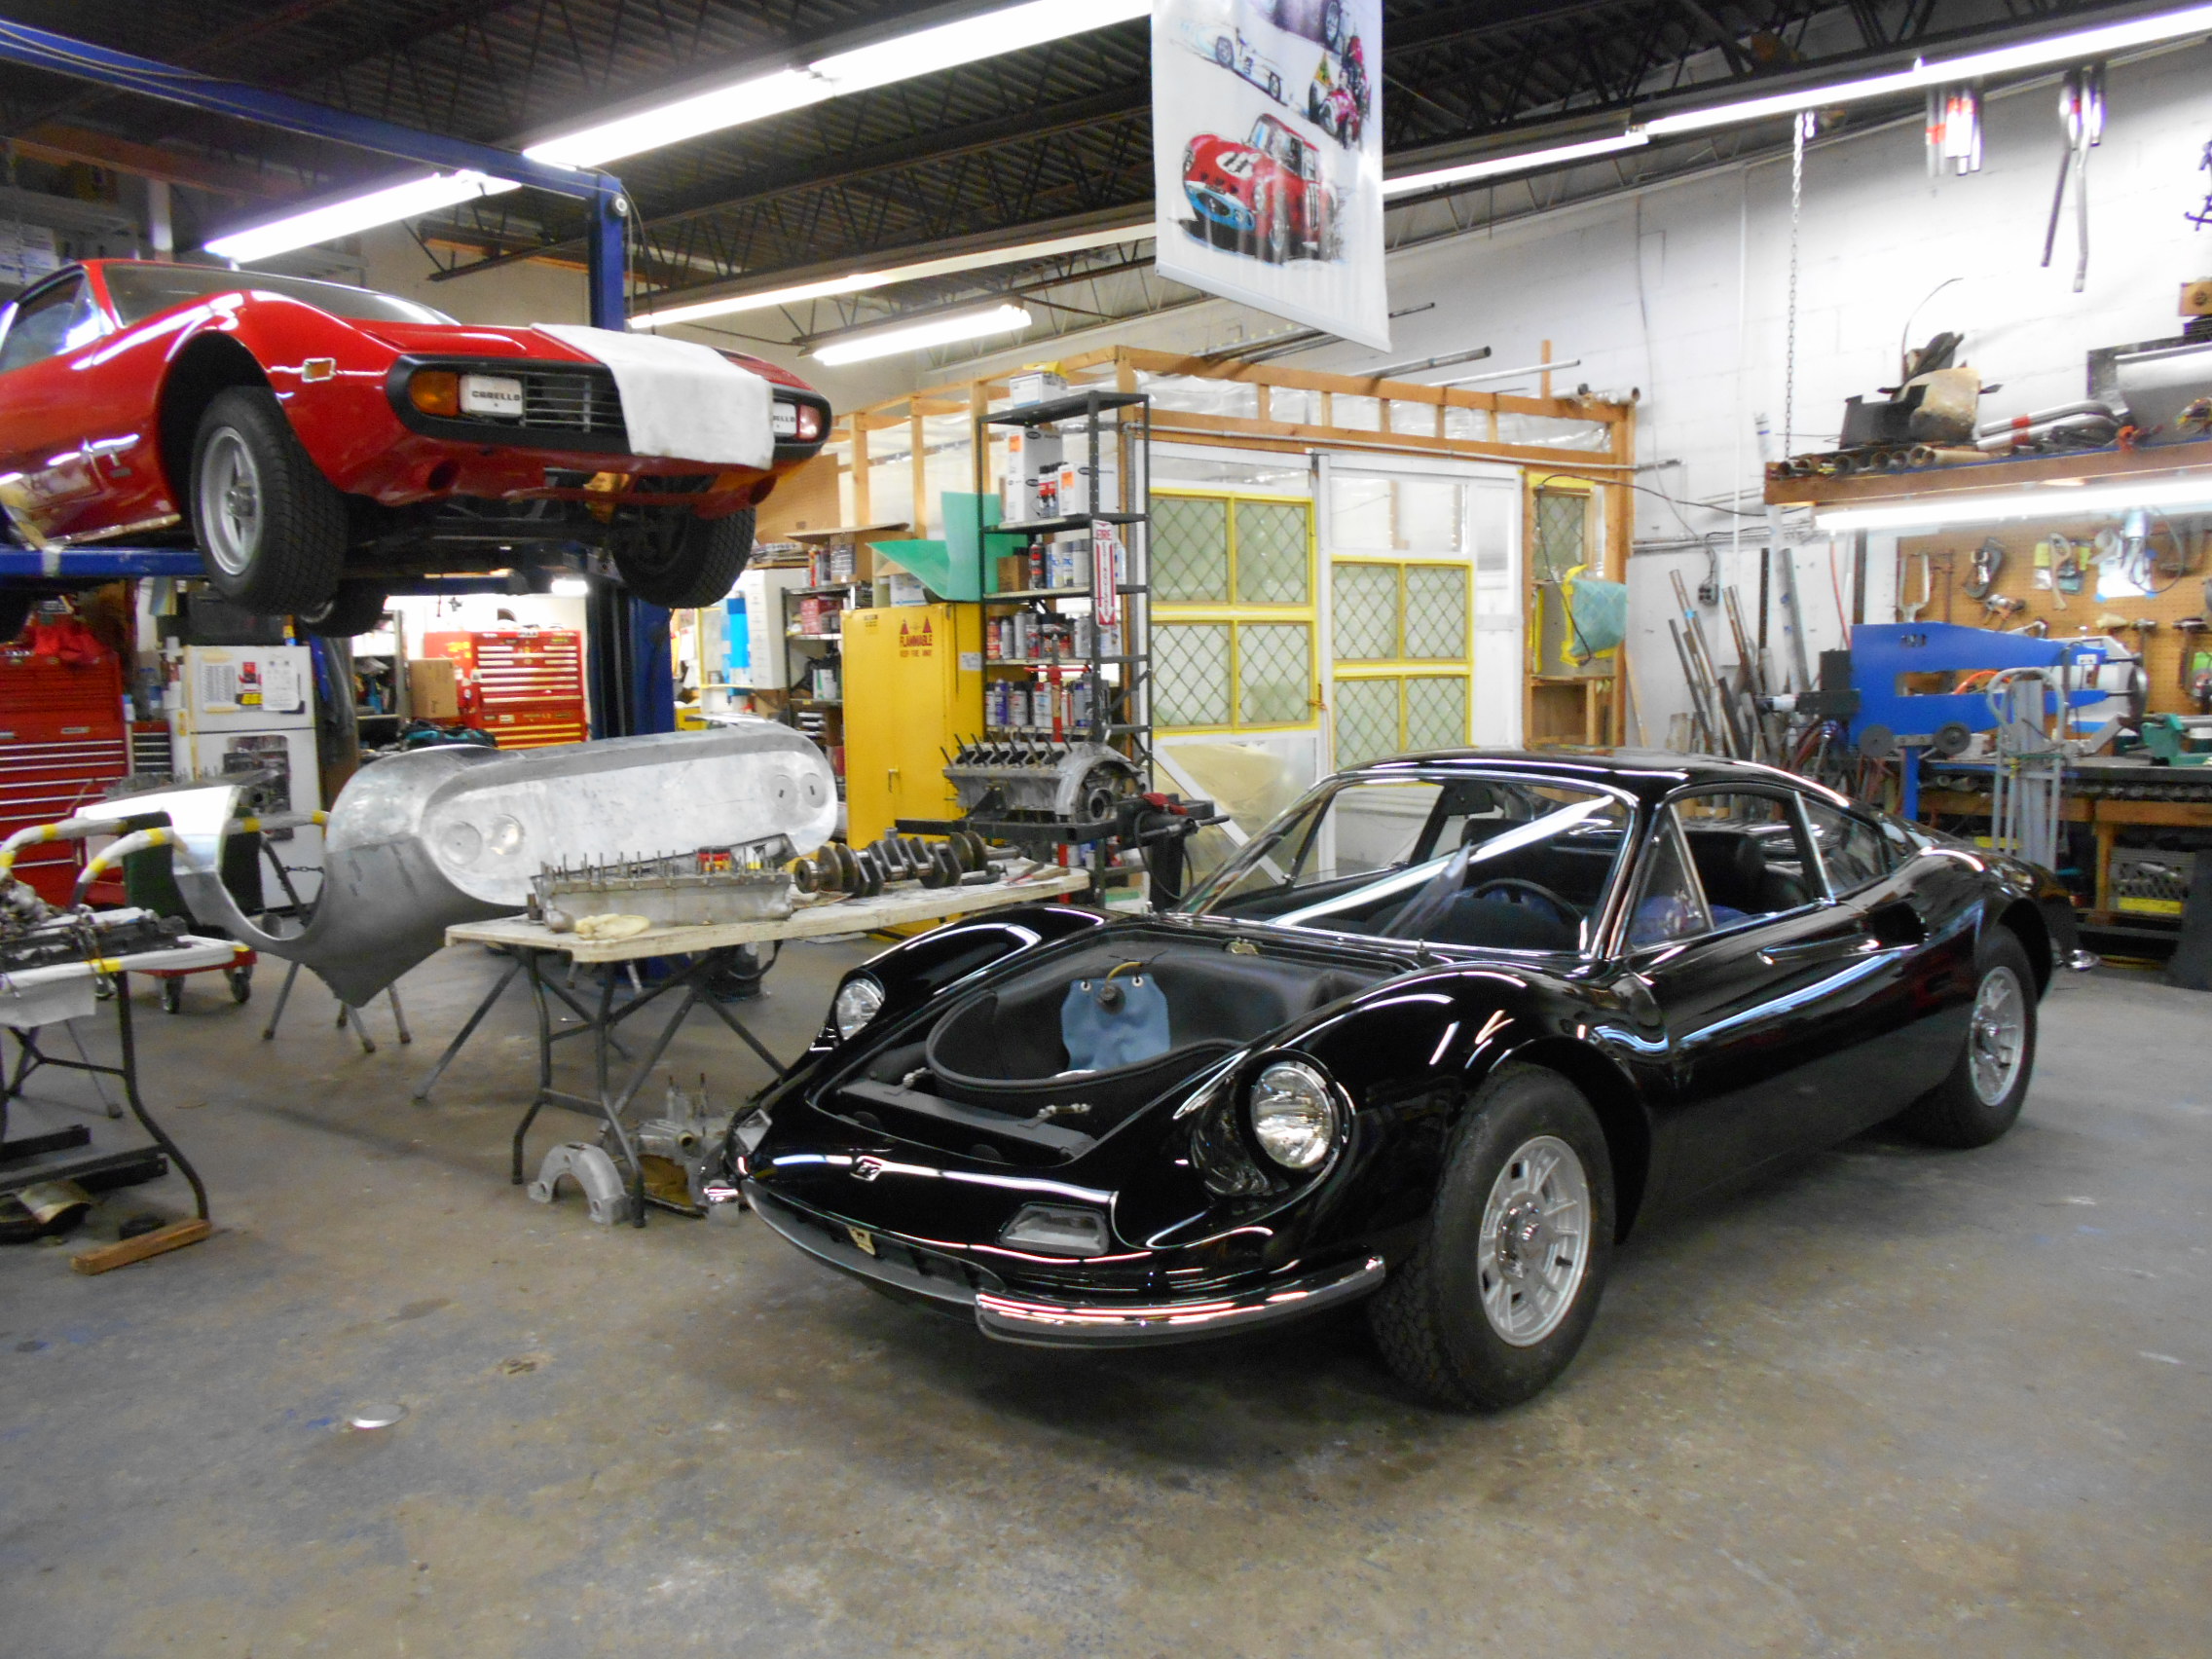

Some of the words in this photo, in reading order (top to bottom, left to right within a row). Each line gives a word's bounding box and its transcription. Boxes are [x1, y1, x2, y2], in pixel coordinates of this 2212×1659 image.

[472, 390, 521, 401] CARELLO
[1096, 529, 1112, 540] FIRE
[900, 634, 933, 647] FLAMMABLE
